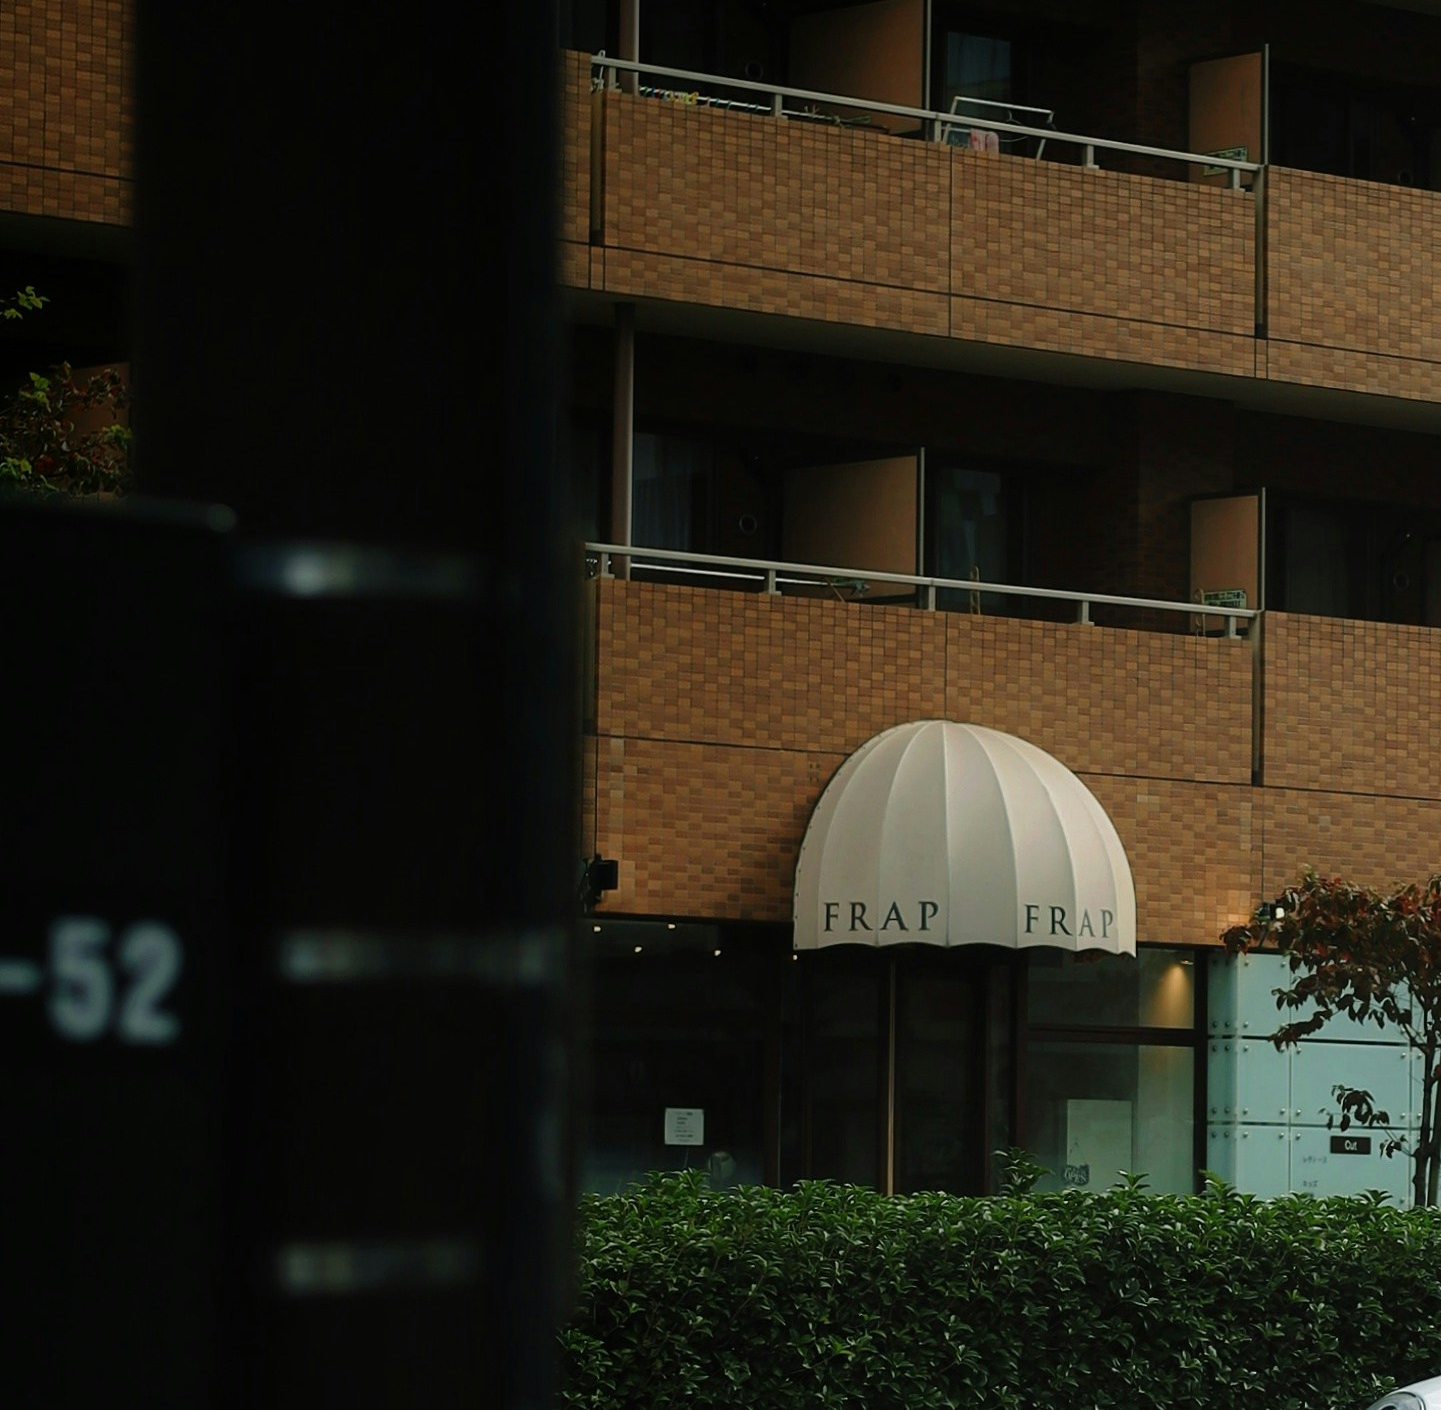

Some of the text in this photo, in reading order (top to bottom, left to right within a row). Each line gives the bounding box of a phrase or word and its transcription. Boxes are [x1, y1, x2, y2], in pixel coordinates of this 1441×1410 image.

[823, 900, 940, 933] FRAP
[1023, 903, 1116, 939] FRAP
[1344, 1139, 1358, 1151] Cut
